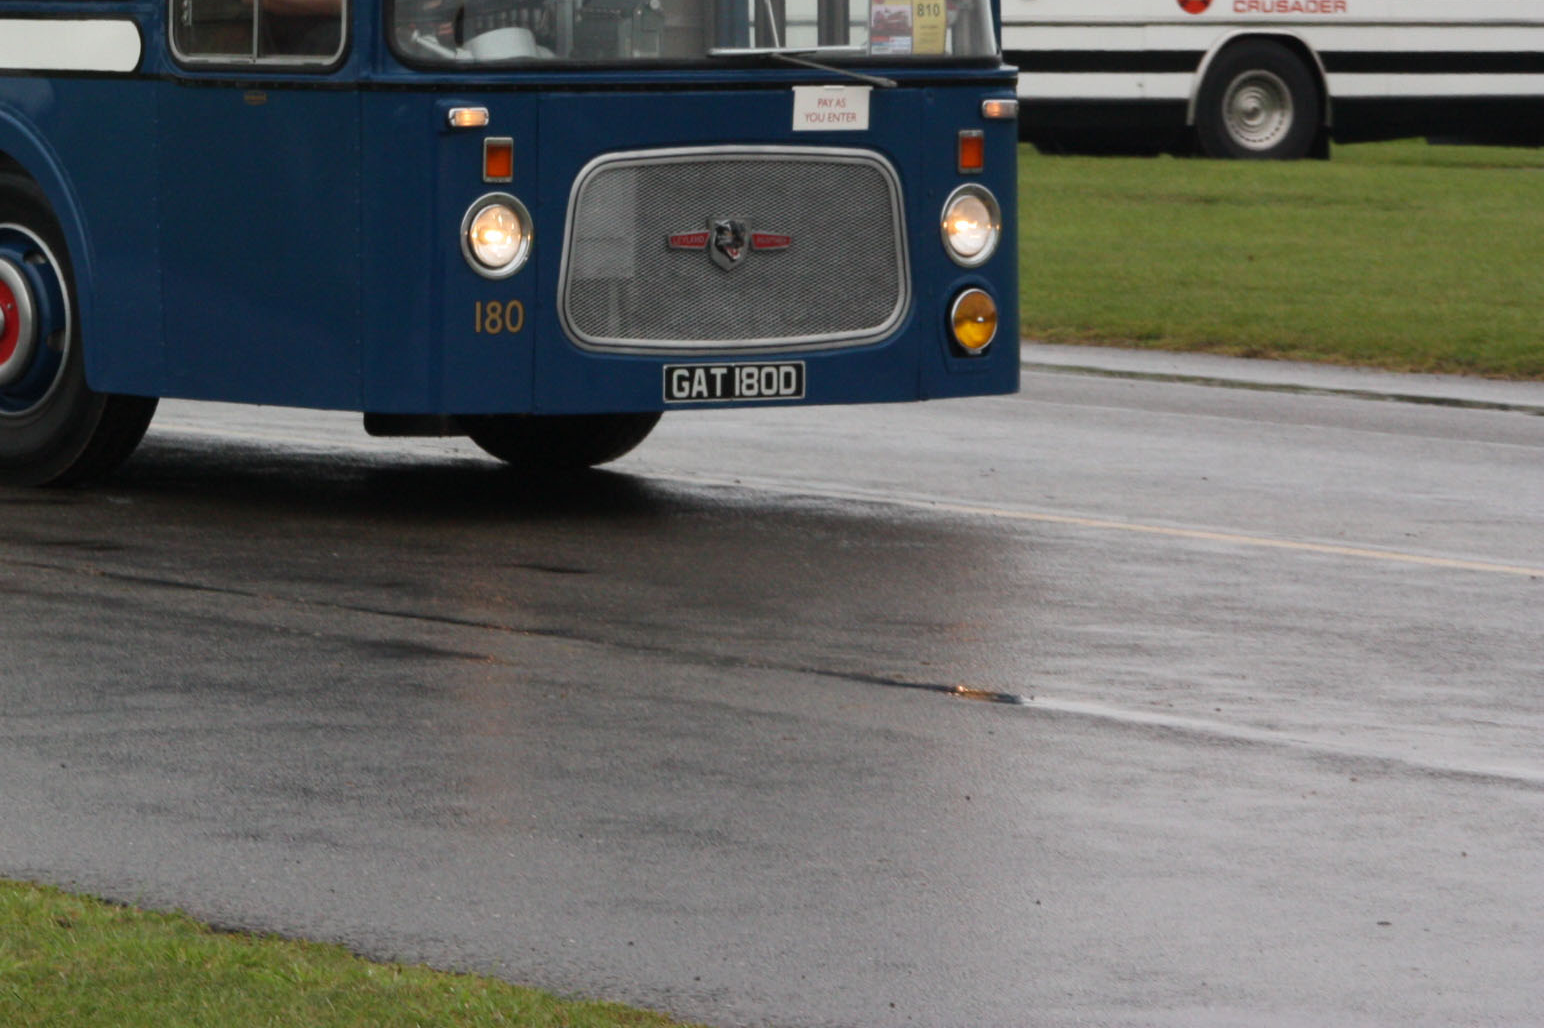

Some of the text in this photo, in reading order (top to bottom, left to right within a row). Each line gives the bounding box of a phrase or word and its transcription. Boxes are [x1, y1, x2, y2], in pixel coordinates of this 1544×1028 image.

[917, 3, 940, 18] 810
[1232, 0, 1347, 14] CRUSADER
[817, 98, 847, 109] PAY AS
[804, 112, 857, 123] YOU ENTER
[475, 300, 524, 334] 180
[672, 365, 796, 398] GAT 180D
